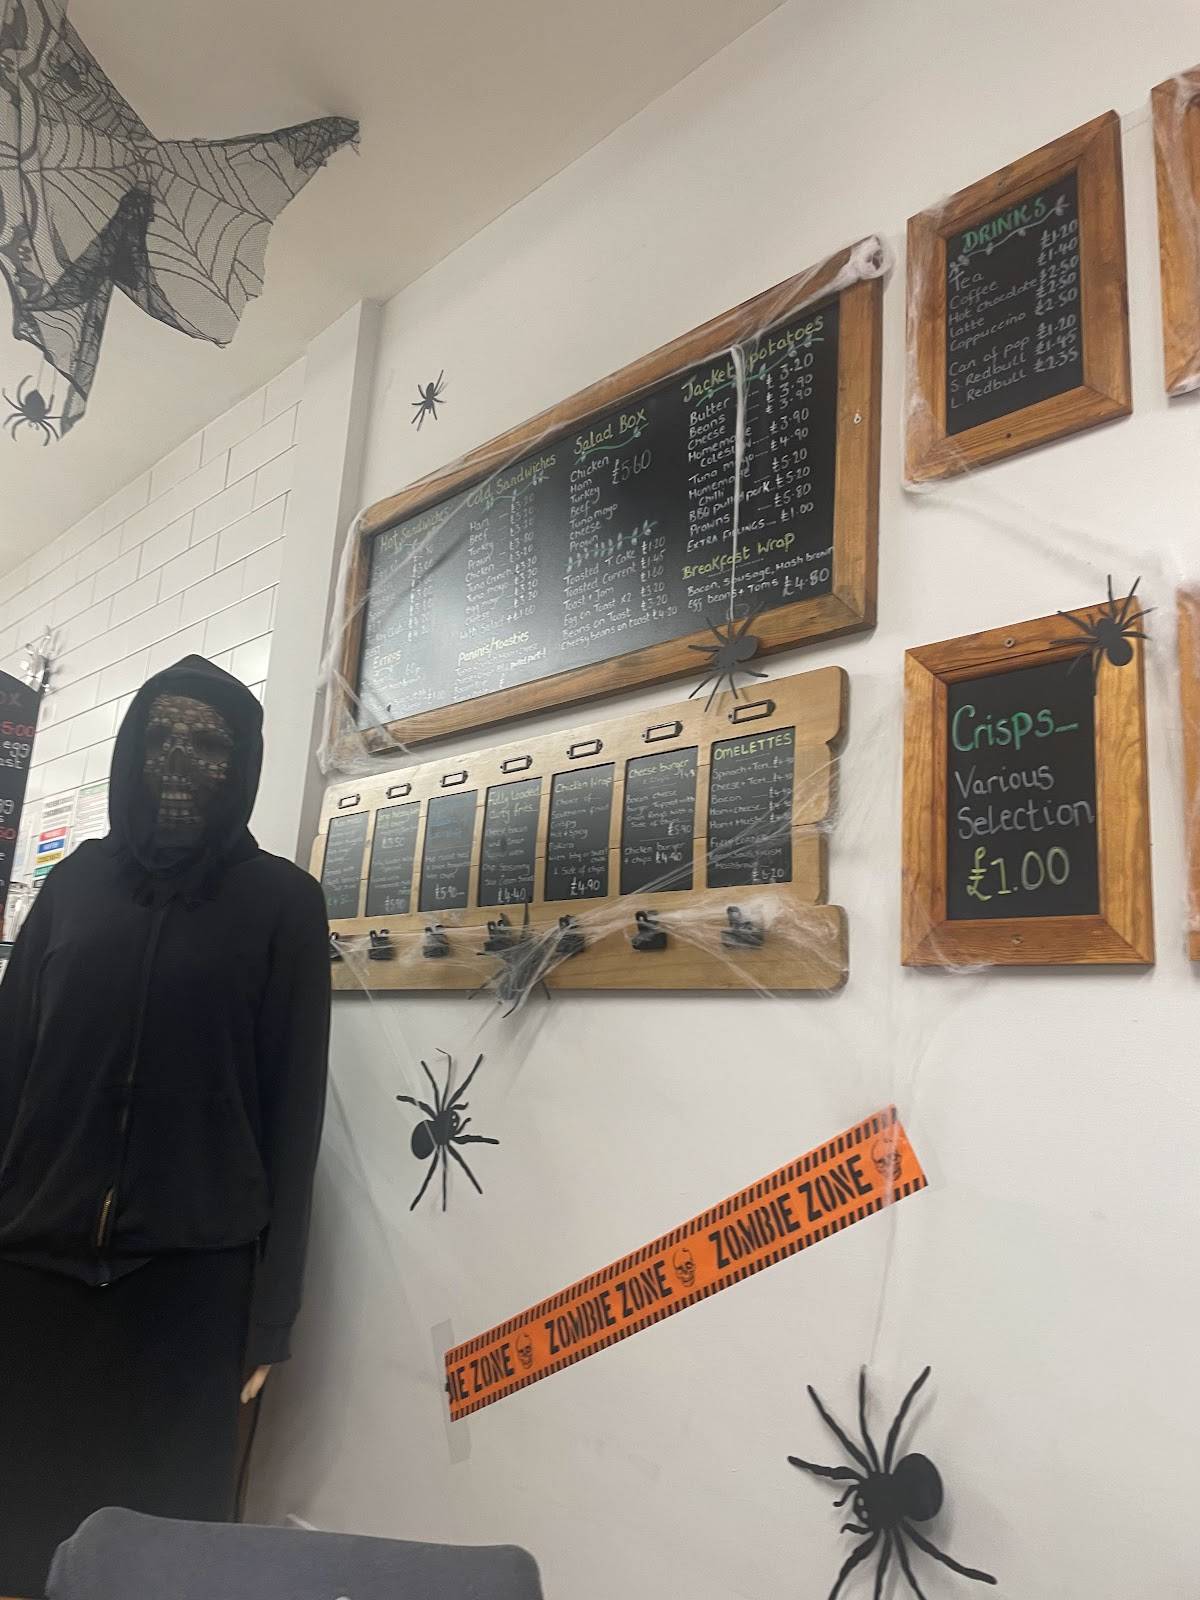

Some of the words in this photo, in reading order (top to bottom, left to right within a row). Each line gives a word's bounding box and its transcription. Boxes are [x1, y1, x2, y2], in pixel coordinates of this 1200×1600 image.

[962, 195, 1047, 254] DRINKS
[950, 270, 985, 292] Tea
[950, 280, 999, 310] Coffee
[948, 306, 973, 326] Hot
[949, 360, 977, 377] Can
[983, 346, 999, 367] of
[1003, 336, 1031, 359] pop
[689, 414, 726, 439] Beans
[690, 397, 730, 427] Butter
[573, 423, 614, 455] Salad
[687, 425, 726, 451] Cheese
[688, 426, 752, 461] Homemae
[570, 456, 609, 483] Chicken
[688, 470, 718, 484] Tuna
[570, 480, 592, 494] Ham
[570, 486, 600, 504] Turkey
[570, 500, 591, 518] Beef
[681, 546, 750, 580] Breakfast
[713, 733, 793, 760] OMELETTES
[954, 765, 1055, 799] Various
[957, 800, 1095, 840] Selection
[966, 846, 1070, 901] £1.00
[470, 1343, 514, 1393] ZONE
[544, 1289, 617, 1355] ZOMBIE
[615, 1259, 673, 1319] ZONE
[708, 1192, 801, 1269] ZOMBIE
[797, 1153, 873, 1223] ZONE
